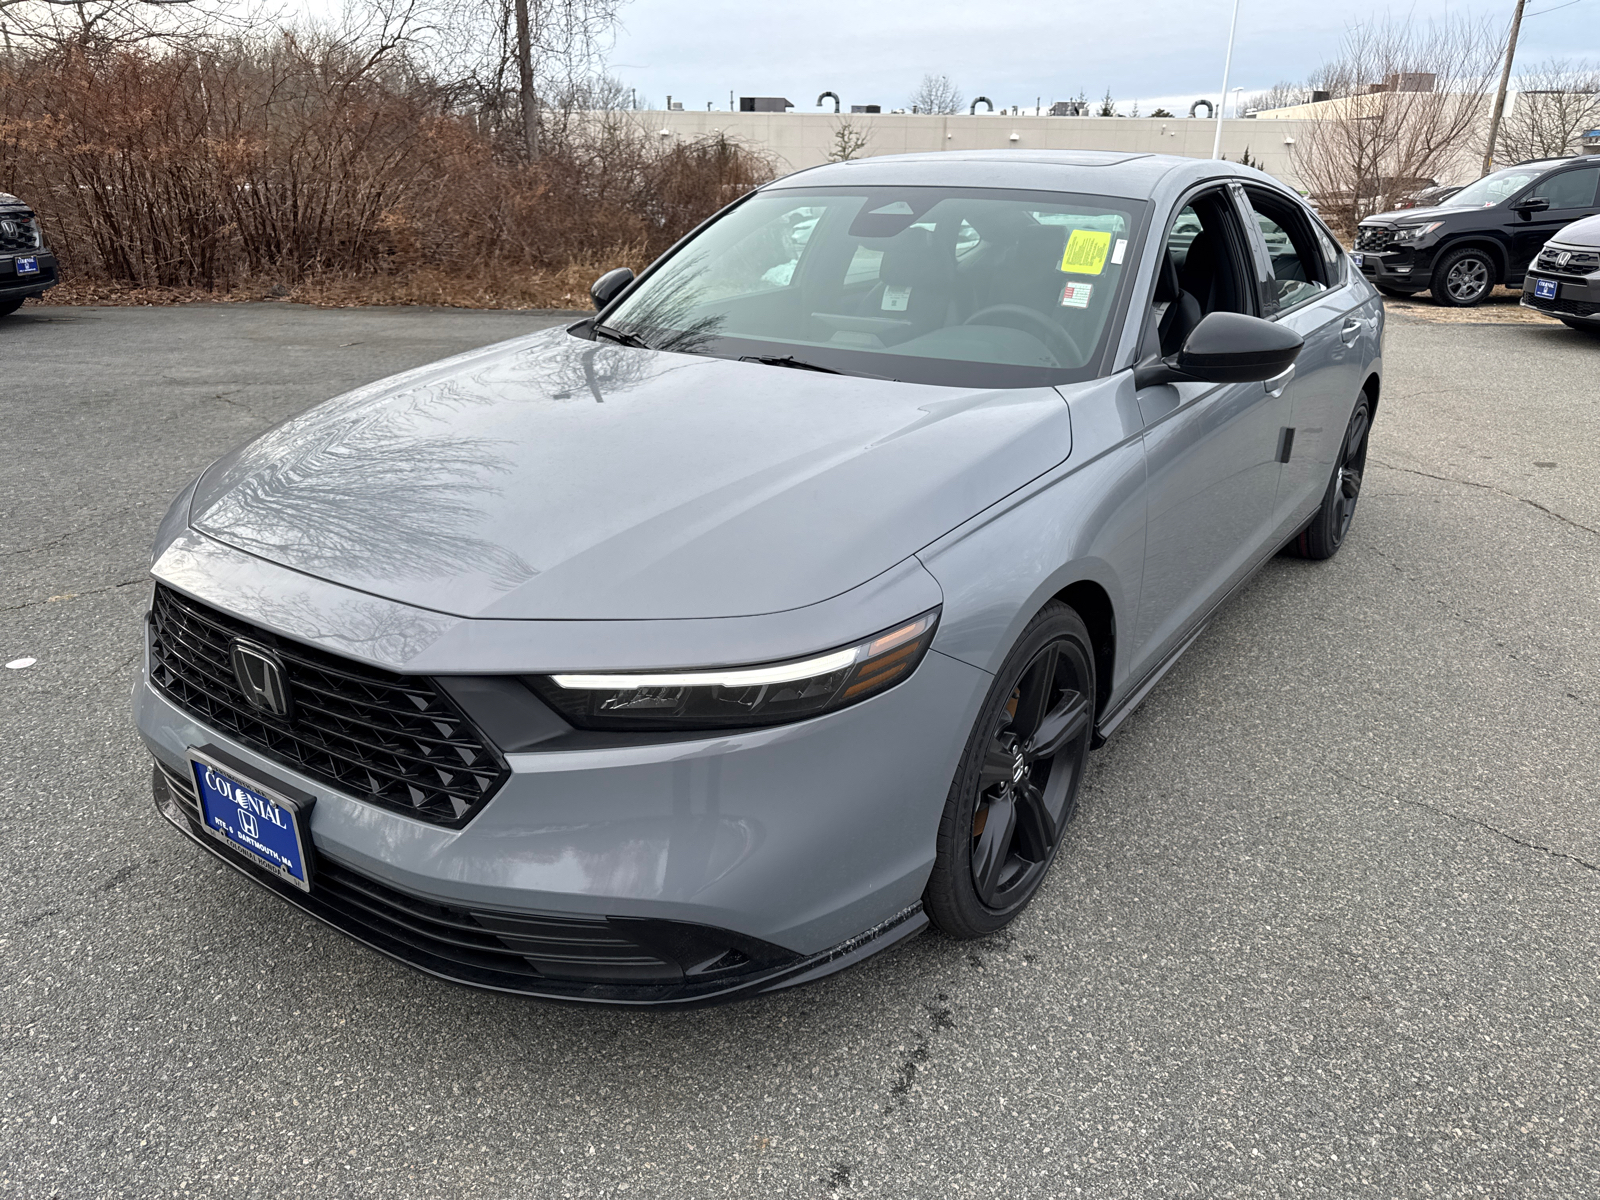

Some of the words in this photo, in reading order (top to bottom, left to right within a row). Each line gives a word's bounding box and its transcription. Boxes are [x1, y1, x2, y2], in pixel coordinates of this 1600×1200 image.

[205, 771, 287, 830] COLONIAL
[226, 838, 257, 862] COLONIAL
[258, 857, 282, 876] HONDA
[237, 831, 282, 863] DARTMOUTH,
[281, 855, 293, 869] MA
